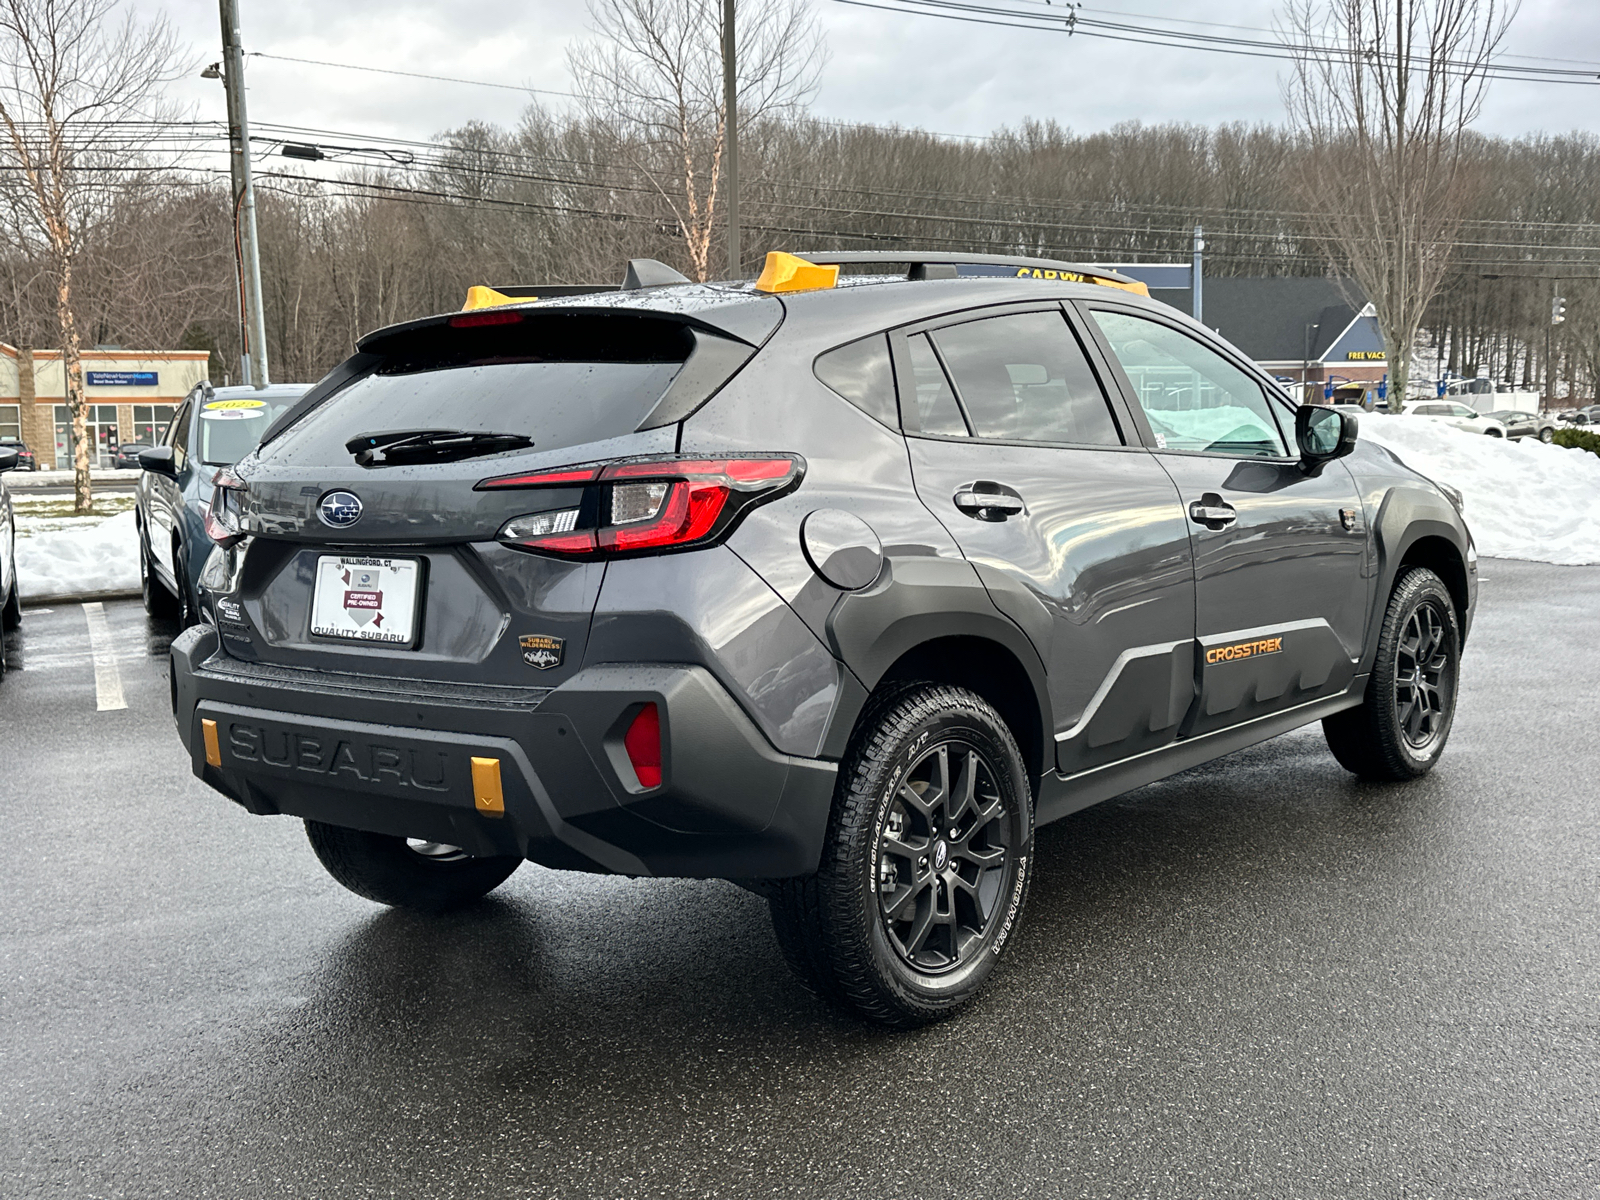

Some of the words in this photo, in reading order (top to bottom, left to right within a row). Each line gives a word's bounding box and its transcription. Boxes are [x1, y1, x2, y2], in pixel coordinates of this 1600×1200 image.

[1348, 351, 1365, 360] FREE
[1367, 351, 1386, 360] VACS
[383, 559, 392, 568] CT
[349, 593, 377, 601] CERTIFIED
[313, 626, 358, 638] QUALITY
[360, 630, 405, 642] SUBARU
[520, 641, 560, 650] WILDERNESS
[1205, 637, 1283, 664] CROSSTREK
[229, 722, 450, 792] SUBARU
[991, 855, 1027, 955] YOKOHAMA
